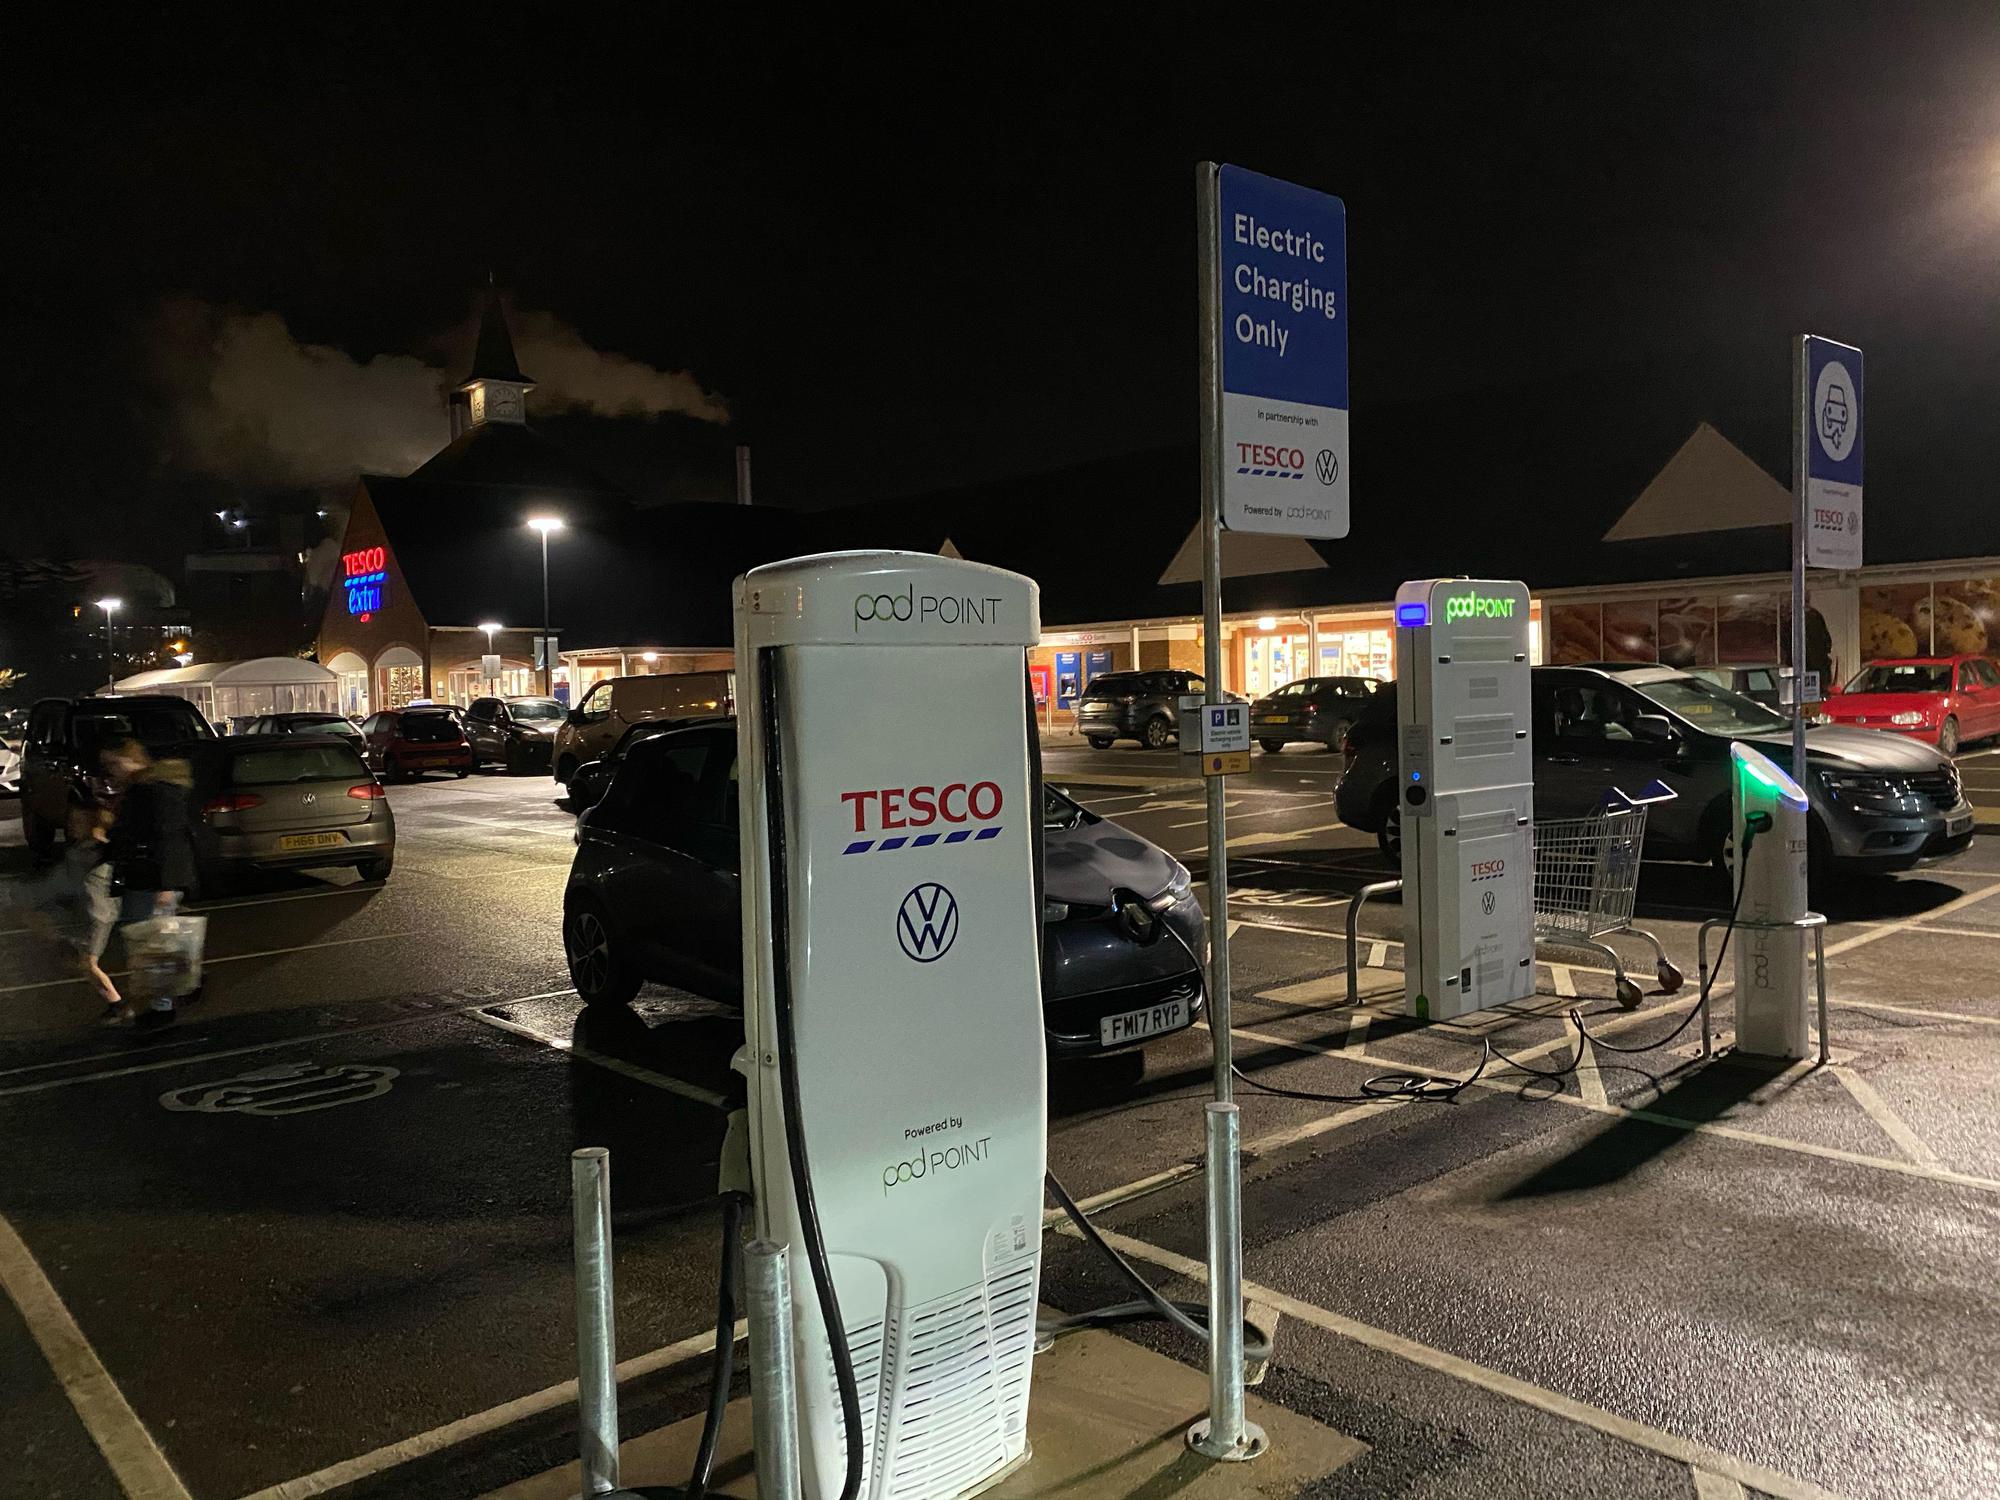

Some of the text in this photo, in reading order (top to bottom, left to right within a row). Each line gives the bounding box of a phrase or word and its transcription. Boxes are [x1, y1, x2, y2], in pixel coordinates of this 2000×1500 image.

[1234, 213, 1325, 263] Electric
[1234, 264, 1336, 320] Charging
[1235, 314, 1289, 357] Only
[1257, 409, 1319, 427] In partnership with
[1236, 443, 1305, 470] TESCO
[1243, 504, 1273, 516] Powered
[1274, 506, 1283, 518] by
[1813, 508, 1844, 526] TESCO
[342, 546, 385, 576] TESCO
[348, 585, 381, 614] extra
[854, 582, 1003, 634] pod POINT
[1447, 591, 1516, 624] pod POINT
[840, 781, 1003, 833] TESCO
[1471, 859, 1505, 877] TESCO
[896, 882, 959, 964] VW
[1112, 1004, 1180, 1039] FM17 RYP
[904, 1116, 963, 1140] Powered by
[882, 1137, 992, 1198] pod POINT
